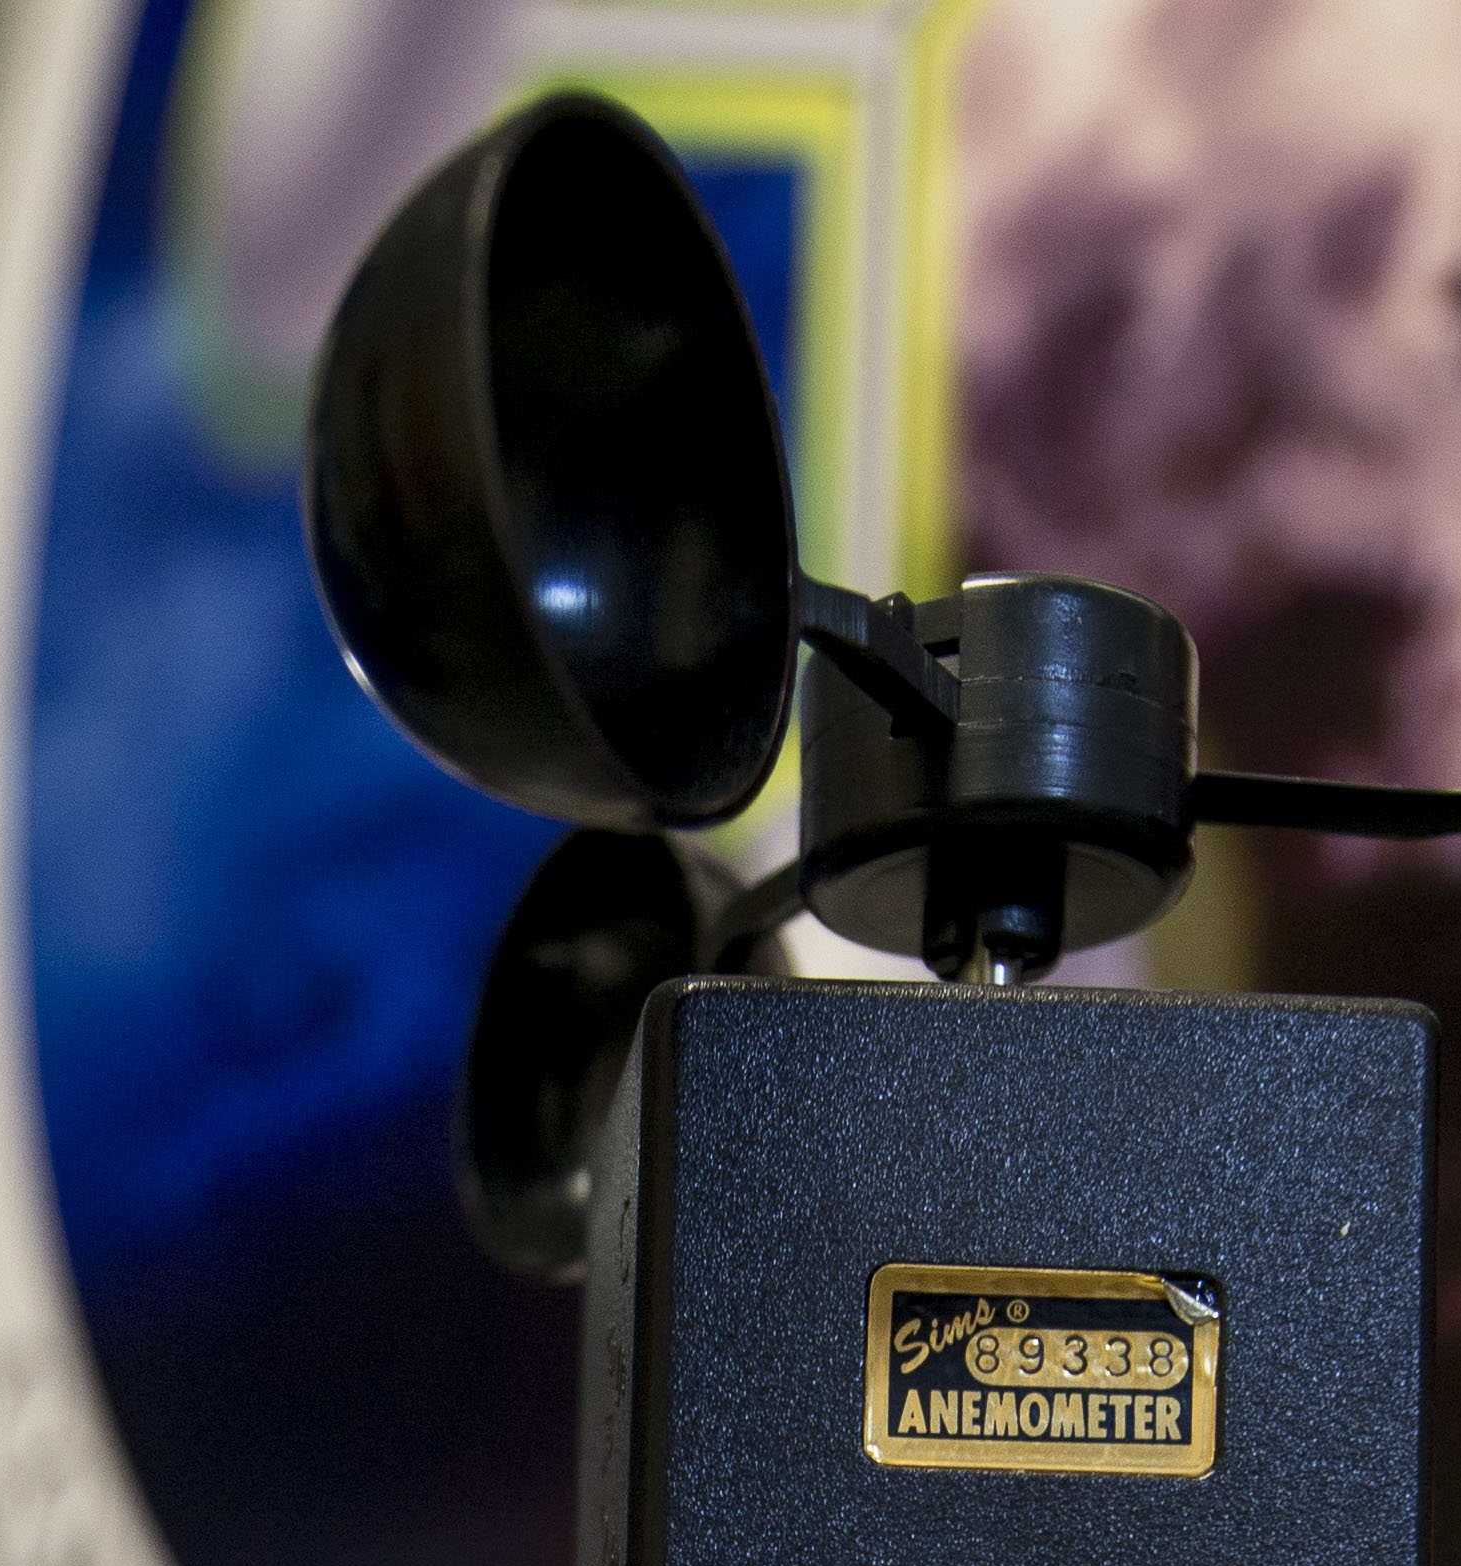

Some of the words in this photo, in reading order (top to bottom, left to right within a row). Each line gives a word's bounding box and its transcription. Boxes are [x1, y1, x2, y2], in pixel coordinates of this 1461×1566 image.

[893, 1298, 995, 1375] Sims
[974, 1334, 1175, 1377] 89338
[897, 1388, 1182, 1440] ANEMOMETER
